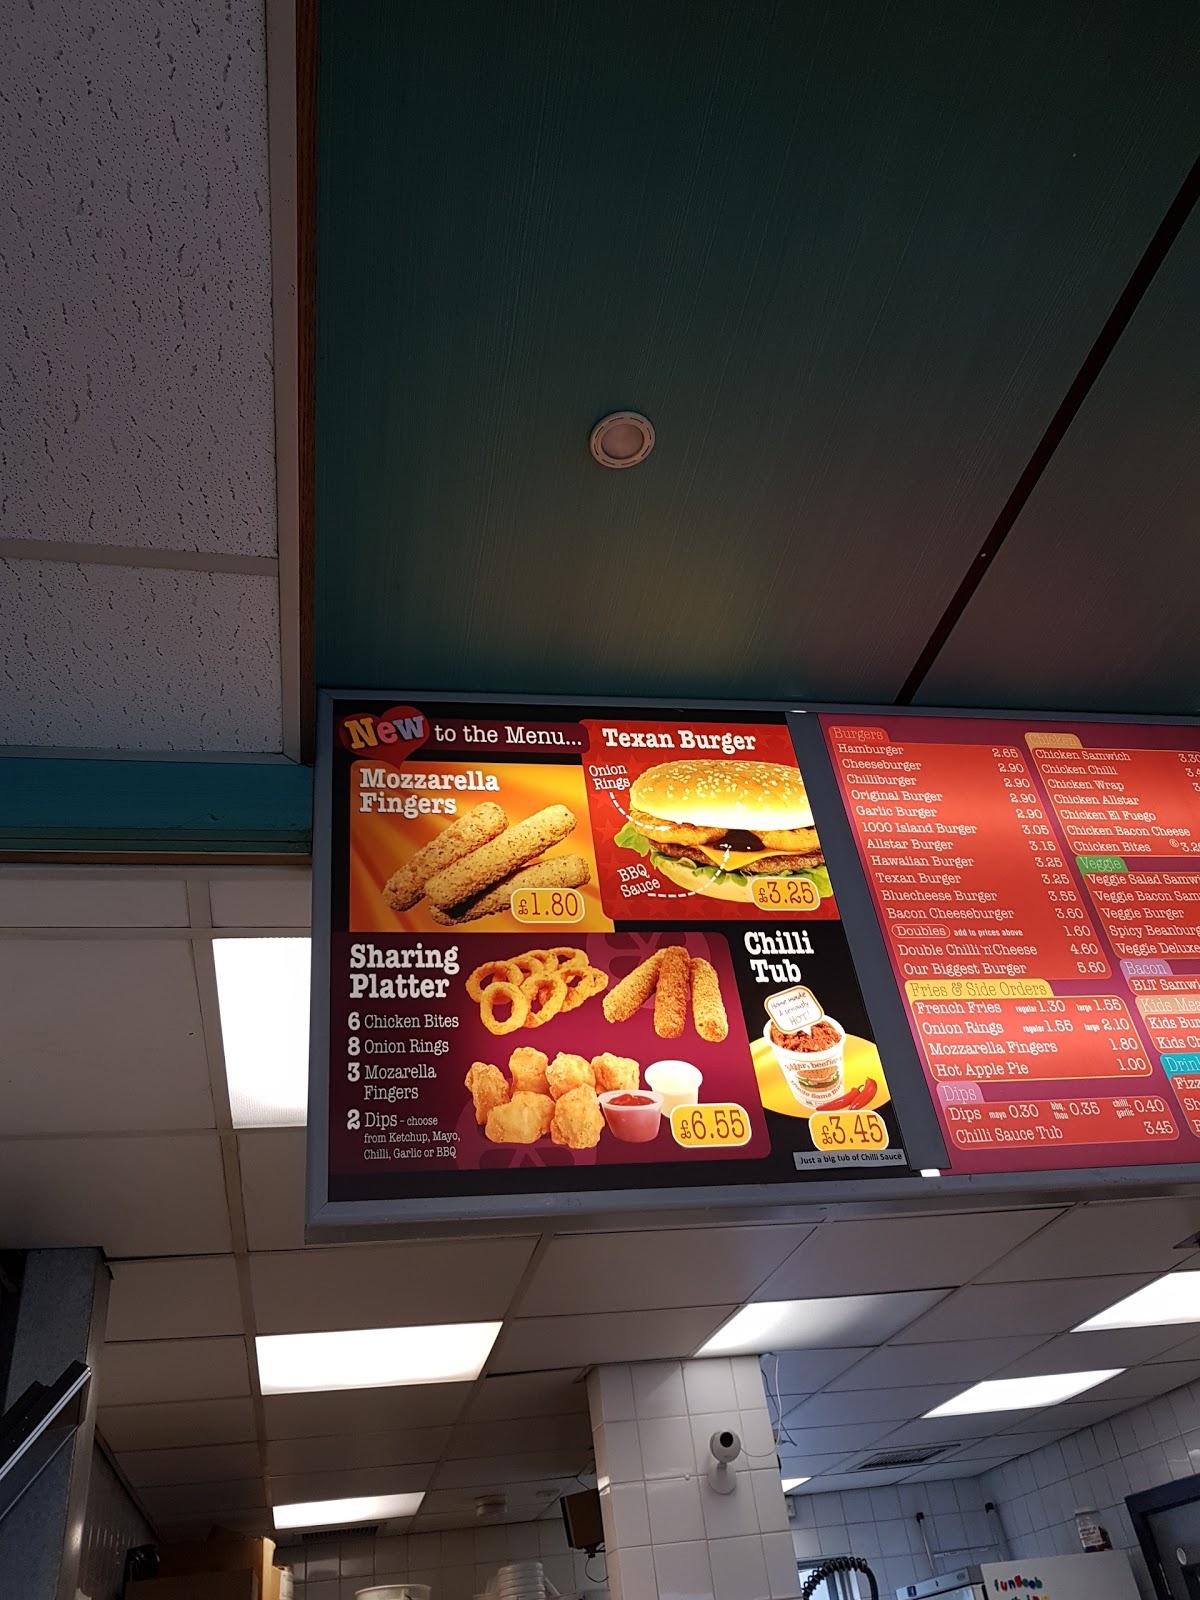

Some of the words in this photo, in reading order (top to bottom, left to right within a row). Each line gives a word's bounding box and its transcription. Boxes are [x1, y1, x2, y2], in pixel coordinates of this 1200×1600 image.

[344, 716, 424, 749] New
[435, 725, 456, 742] to
[463, 725, 498, 743] the
[505, 727, 582, 746] Menu...
[833, 728, 884, 741] Burgers
[602, 728, 675, 749] Texan
[677, 729, 755, 754] Burger
[837, 744, 904, 757] Hamburger
[992, 748, 1018, 758] 2.65
[1035, 749, 1080, 760] Chicken
[1081, 751, 1131, 761] Samwich
[588, 764, 627, 777] Onion
[842, 759, 922, 772] Cheeseburger
[998, 763, 1024, 773] 2.90
[1041, 764, 1087, 775] Chicken
[1088, 765, 1118, 775] Chilli
[359, 768, 500, 792] Mozzarella
[593, 776, 630, 791] Rings
[846, 774, 917, 787] Chilliburger
[1004, 778, 1030, 788] 2.90
[1047, 779, 1093, 790] Chicken
[1094, 780, 1125, 792] Wrap
[851, 789, 900, 802] Original
[902, 791, 943, 804] Burger
[1010, 793, 1036, 803] 2.90
[1053, 794, 1100, 805] Chicken
[1102, 795, 1140, 805] Allstar
[359, 792, 457, 819] Fingers
[856, 806, 893, 817] Garlic
[895, 806, 938, 820] Burger
[1016, 809, 1043, 819] 2.90
[1060, 809, 1106, 820] Chicken
[1108, 810, 1121, 820] El
[1122, 810, 1157, 822] Fuego
[861, 822, 893, 833] 1000
[895, 822, 933, 833] Island
[936, 823, 978, 836] Burger
[1021, 824, 1050, 835] 3.05
[1066, 825, 1113, 836] Chicken
[1114, 826, 1150, 836] Bacon
[1151, 826, 1191, 837] Cheese
[866, 838, 910, 850] Allstar
[912, 839, 954, 852] Burger
[1029, 840, 1056, 851] 3.15
[1073, 841, 1119, 852] Chicken
[1121, 842, 1152, 852] Bites
[870, 855, 930, 867] Hawaiian
[930, 856, 975, 869] Burger
[1034, 857, 1063, 868] 3.25
[1080, 856, 1122, 872] Veggie
[617, 863, 650, 882] BBQ
[875, 872, 916, 884] Texan
[917, 873, 962, 886] Burger
[1041, 873, 1070, 885] 3.25
[1087, 873, 1127, 886] Veggie
[1128, 873, 1160, 885] Salad
[620, 877, 661, 898] Sauce
[758, 881, 815, 904] £3.25
[881, 889, 952, 901] Bluecheese
[953, 890, 998, 903] Burger
[1093, 890, 1134, 903] Veggie
[1134, 891, 1172, 902] Bacon
[517, 892, 579, 918] £1.80
[886, 907, 927, 919] Bacon
[929, 907, 1015, 921] Cheeseburger
[1055, 908, 1083, 919] 3.60
[1100, 907, 1141, 920] Veggie
[1143, 907, 1184, 920] Burger
[896, 925, 947, 937] Doubles
[954, 928, 968, 937] add
[968, 928, 976, 937] to
[977, 929, 1000, 938] prices
[1002, 928, 1023, 937] above
[1063, 925, 1091, 937] 1.60
[1109, 925, 1142, 939] Spicy
[744, 930, 814, 955] Chilli
[897, 944, 943, 956] Double
[1070, 943, 1098, 955] 4.60
[1116, 943, 1157, 956] Veggie
[350, 943, 460, 974] Sharing
[750, 958, 802, 983] Tub
[904, 963, 929, 975] Our
[931, 963, 980, 977] Biggest
[981, 962, 1027, 977] Burger
[1125, 961, 1167, 975] Bacon
[350, 974, 449, 999] Platter
[909, 982, 948, 997] Fries
[952, 982, 963, 996] &
[965, 981, 996, 996] Side
[999, 981, 1048, 996] Orders
[1131, 979, 1157, 991] BLT
[915, 1001, 963, 1015] French
[966, 1000, 1002, 1014] Fries
[1015, 1004, 1037, 1014] regular
[1037, 1000, 1066, 1012] 1.30
[1093, 998, 1122, 1011] 1.55
[1139, 997, 1173, 1013] Kids
[348, 1012, 360, 1030] 6
[364, 1014, 421, 1029] Chicken
[423, 1014, 459, 1029] Bites
[922, 1021, 963, 1035] Onion
[964, 1021, 1004, 1036] Rings
[1023, 1025, 1045, 1034] regular
[1044, 1019, 1073, 1032] 1.55
[1101, 1018, 1130, 1031] 2.10
[1148, 1016, 1177, 1029] Kids
[348, 1036, 360, 1056] 8
[364, 1039, 406, 1054] Onion
[409, 1038, 449, 1056] Rings
[928, 1041, 1006, 1056] Mozzarella
[1006, 1041, 1058, 1056] Fingers
[1109, 1037, 1138, 1051] 1.80
[1156, 1036, 1186, 1049] Kids
[348, 1062, 360, 1082] 3
[364, 1064, 437, 1080] Mozarella
[935, 1063, 963, 1077] Hot
[965, 1063, 1005, 1079] Apple
[1006, 1062, 1029, 1075] Pie
[1116, 1058, 1147, 1071] 1.00
[364, 1085, 419, 1103] Fingers
[941, 1085, 977, 1103] Dips
[1069, 1102, 1101, 1116] 0.35
[1134, 1098, 1165, 1113] 0.40
[347, 1109, 360, 1130] 2
[364, 1111, 398, 1130] Dips
[406, 1115, 438, 1126] choose
[949, 1107, 982, 1123] Dips
[989, 1110, 1007, 1120] mayo
[1008, 1104, 1039, 1118] 0.30
[680, 1109, 745, 1140] £6.55
[821, 1115, 884, 1145] £3.45
[364, 1132, 387, 1143] from
[389, 1131, 431, 1145] Ketchup,
[432, 1131, 461, 1143] Mayo,
[955, 1127, 993, 1144] Chilli
[995, 1126, 1035, 1142] Sauce
[1035, 1125, 1063, 1140] Tub
[1143, 1120, 1173, 1135] 3.45
[364, 1148, 392, 1160] Chilli,
[393, 1147, 422, 1160] Garlic
[424, 1149, 434, 1158] or
[436, 1146, 457, 1160] BBQ
[823, 1155, 836, 1163] big
[852, 1153, 861, 1161] of
[861, 1153, 878, 1161] Chilli
[880, 1153, 902, 1161] Sauce
